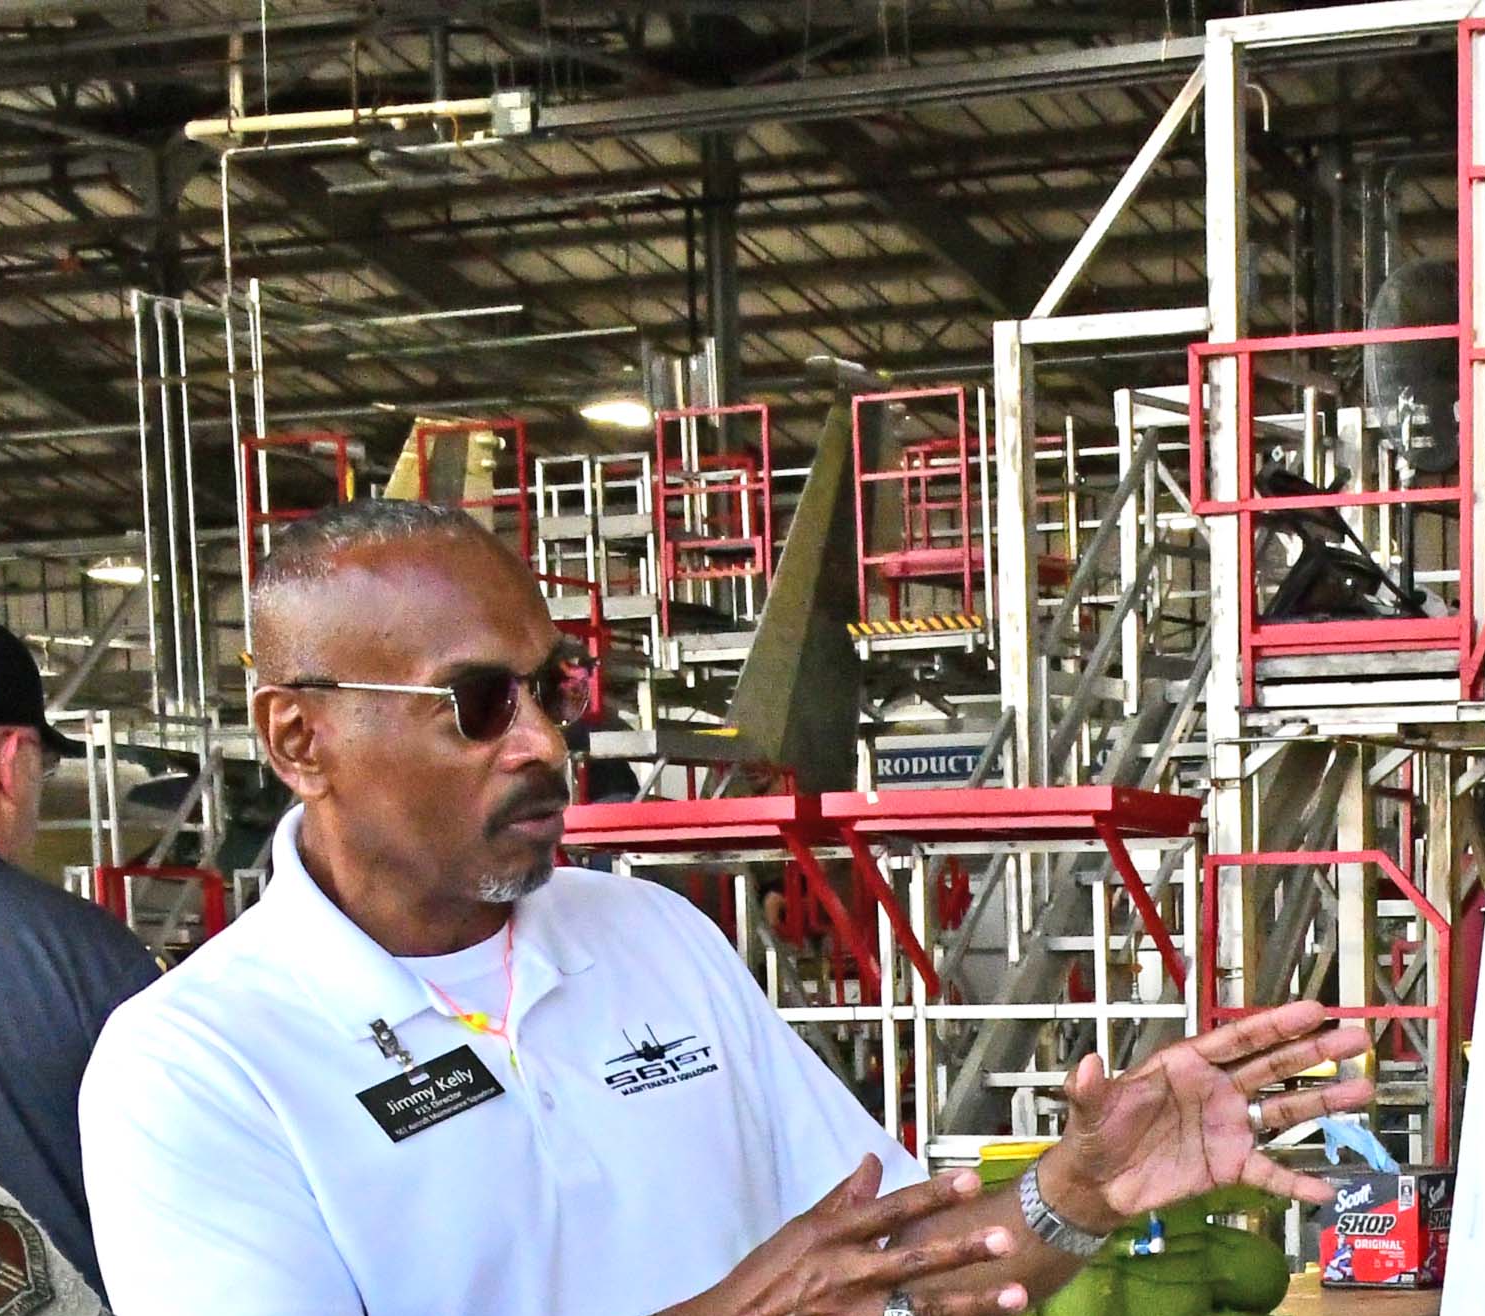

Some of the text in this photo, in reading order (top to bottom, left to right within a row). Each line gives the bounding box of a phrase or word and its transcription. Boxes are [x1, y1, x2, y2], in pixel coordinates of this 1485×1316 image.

[387, 1068, 475, 1116] Jimmy Kelly
[621, 1063, 719, 1097] MAINTENANCE SQUADRON
[430, 1090, 463, 1110] Director
[1335, 1184, 1374, 1213] Scott
[1335, 1213, 1396, 1236] SHOP
[1354, 1239, 1402, 1250] ORIGINAL
